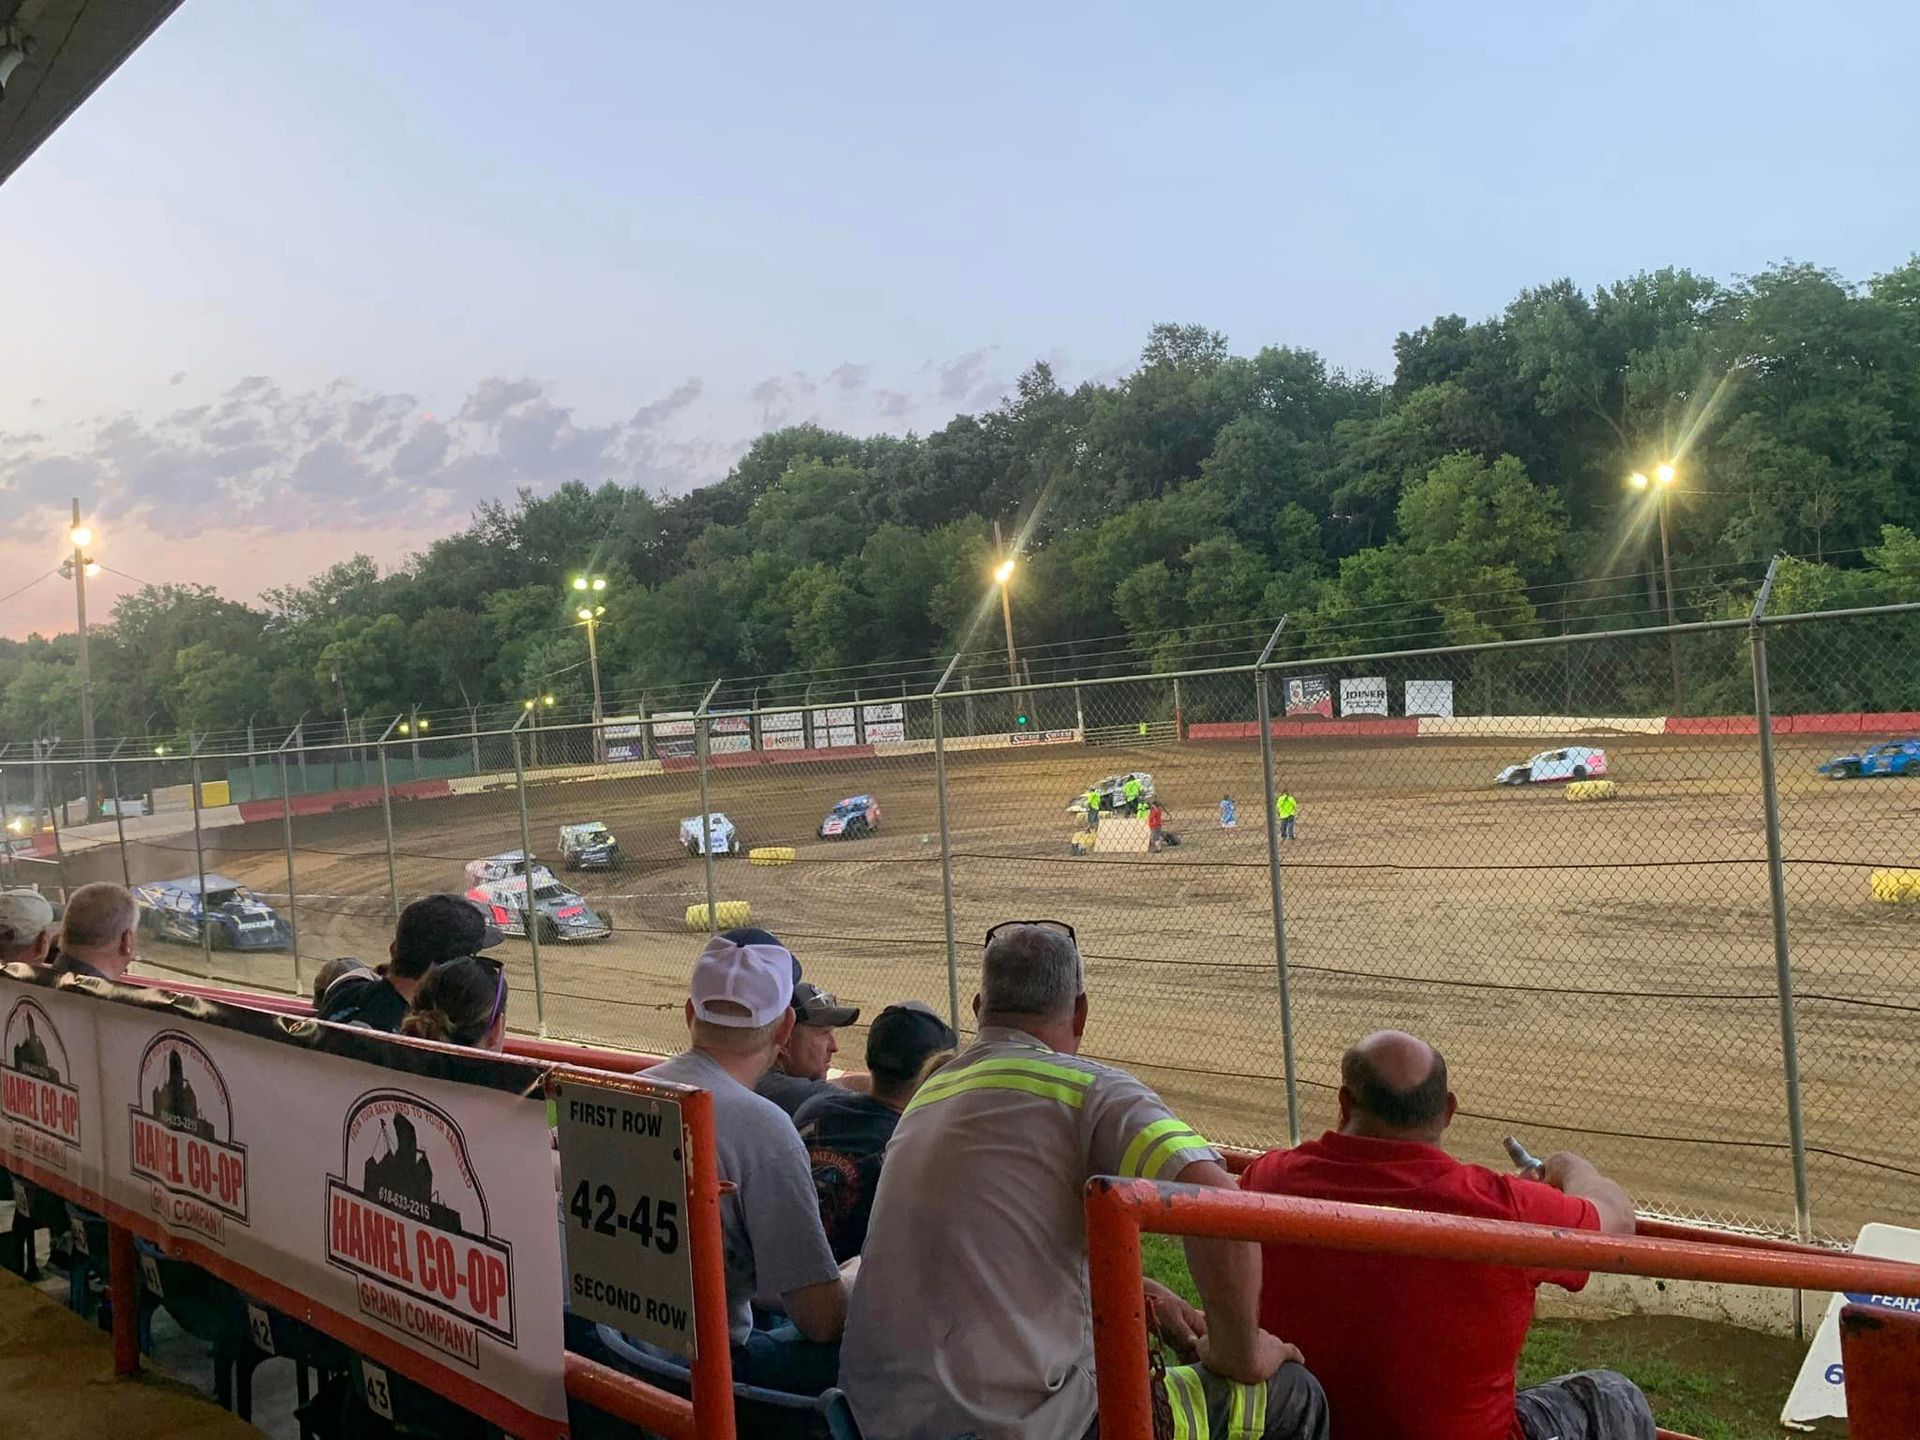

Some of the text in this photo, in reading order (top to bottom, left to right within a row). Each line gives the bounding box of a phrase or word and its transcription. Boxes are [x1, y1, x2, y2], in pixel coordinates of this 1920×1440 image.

[41, 1085, 77, 1136] CO-OP
[570, 1100, 662, 1137] FIRST ROW
[188, 1140, 242, 1206] CO-OP
[378, 1187, 430, 1219] 618-633-2215
[570, 1179, 678, 1254] 42-45
[332, 1195, 506, 1320] HAMEL CO-OP
[361, 1283, 473, 1357] GRAIN COMPANY
[574, 1273, 687, 1331] SECOND ROW
[1871, 1294, 1920, 1312] FEAR
[252, 1318, 272, 1346] 42
[367, 1376, 389, 1409] 43
